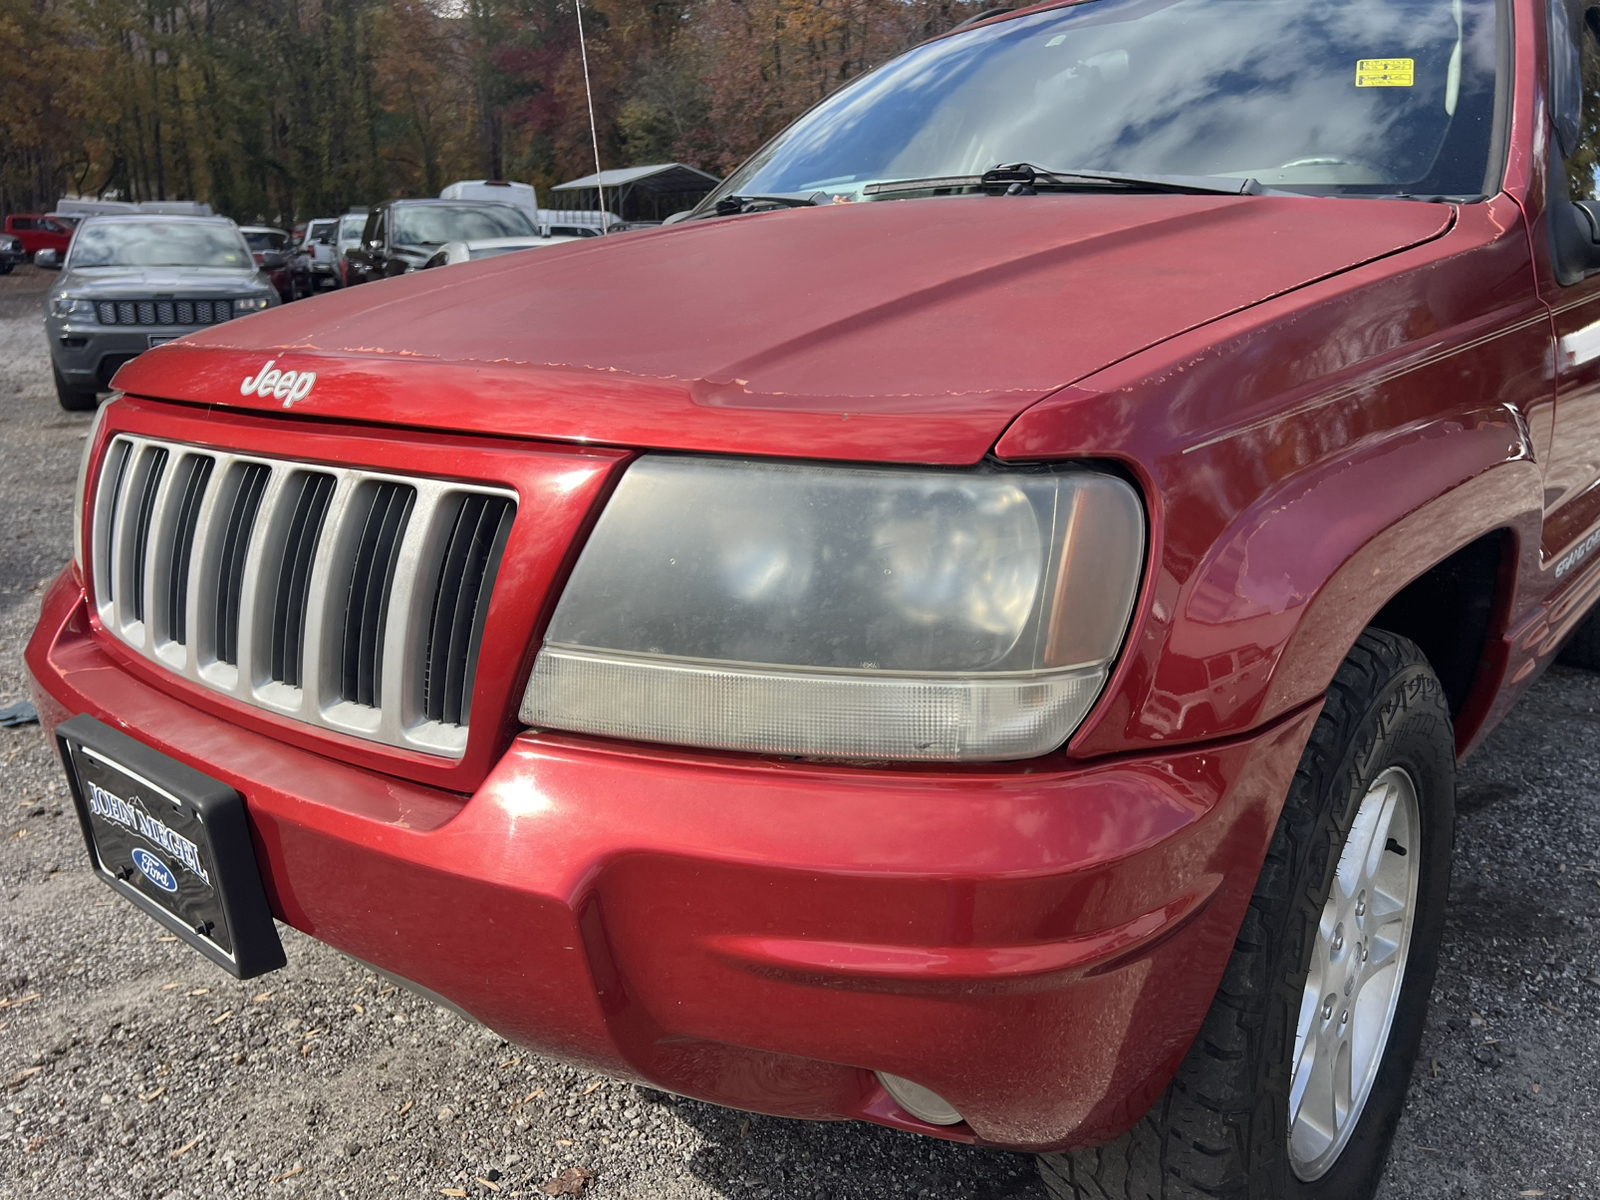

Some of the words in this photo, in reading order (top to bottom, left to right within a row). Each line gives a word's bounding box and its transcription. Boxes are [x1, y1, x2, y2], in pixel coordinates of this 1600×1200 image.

[240, 360, 317, 408] Jeep
[88, 781, 138, 830] JOHN
[135, 809, 209, 885] MEGEL
[141, 853, 170, 887] Ford
